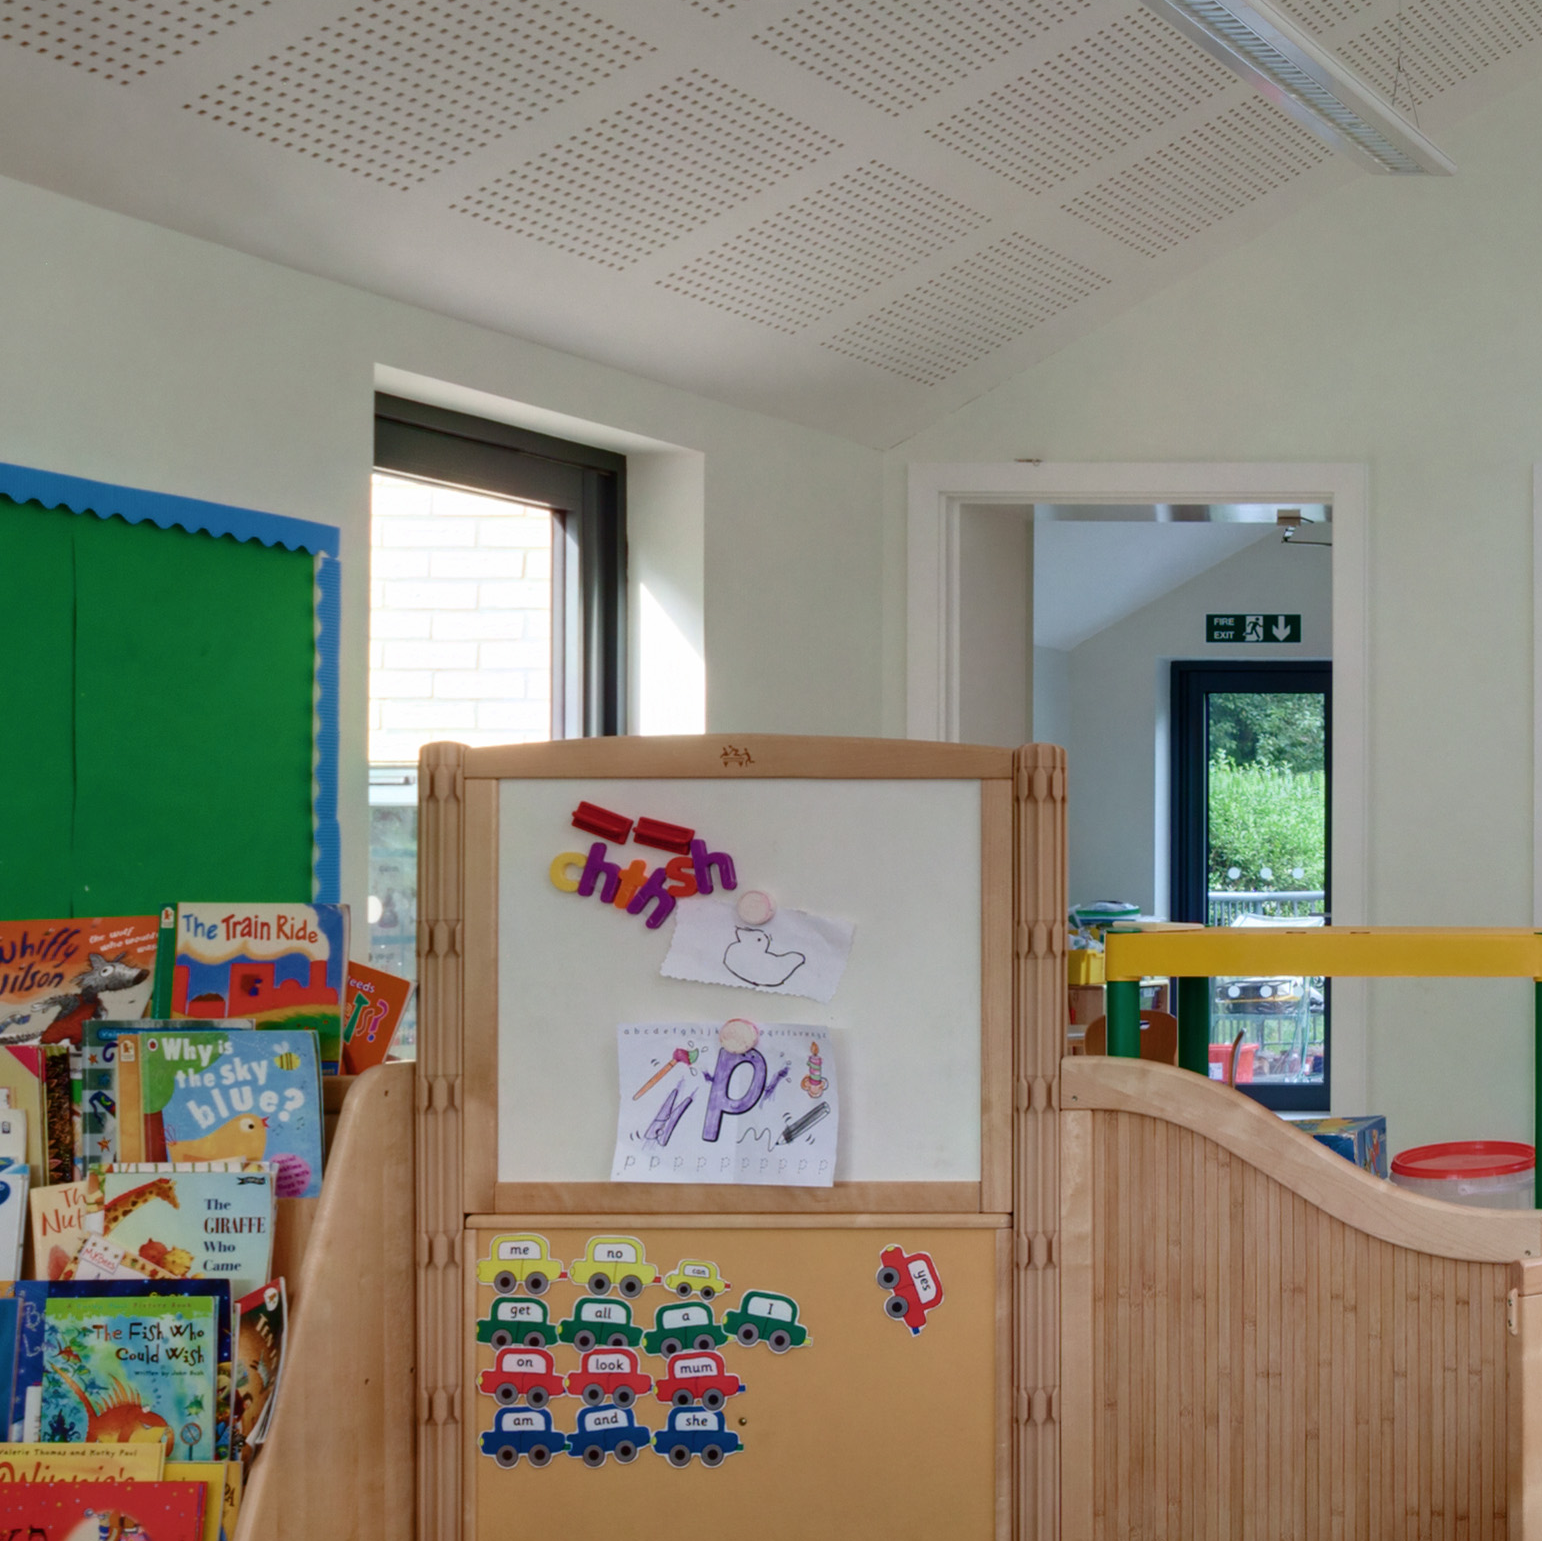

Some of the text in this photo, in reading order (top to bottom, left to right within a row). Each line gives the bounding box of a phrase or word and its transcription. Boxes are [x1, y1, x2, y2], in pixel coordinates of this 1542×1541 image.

[1214, 617, 1235, 626] FIRE
[1214, 631, 1235, 639] EXIT
[183, 914, 318, 944] The Train Ride
[161, 1038, 234, 1067] Why is
[176, 1068, 216, 1089] the
[186, 1086, 305, 1129] blue?
[204, 1199, 231, 1211] The
[204, 1216, 266, 1234] GIRAFFE
[204, 1241, 236, 1253] Who
[203, 1261, 241, 1272] Came
[510, 1245, 707, 1276] me no can
[913, 1269, 931, 1292] yes
[510, 1303, 774, 1322] get all a I
[92, 1322, 205, 1342] The Fish Who
[115, 1345, 205, 1367] Could Wish
[517, 1356, 713, 1374] on look mum
[513, 1414, 708, 1427] am and she
